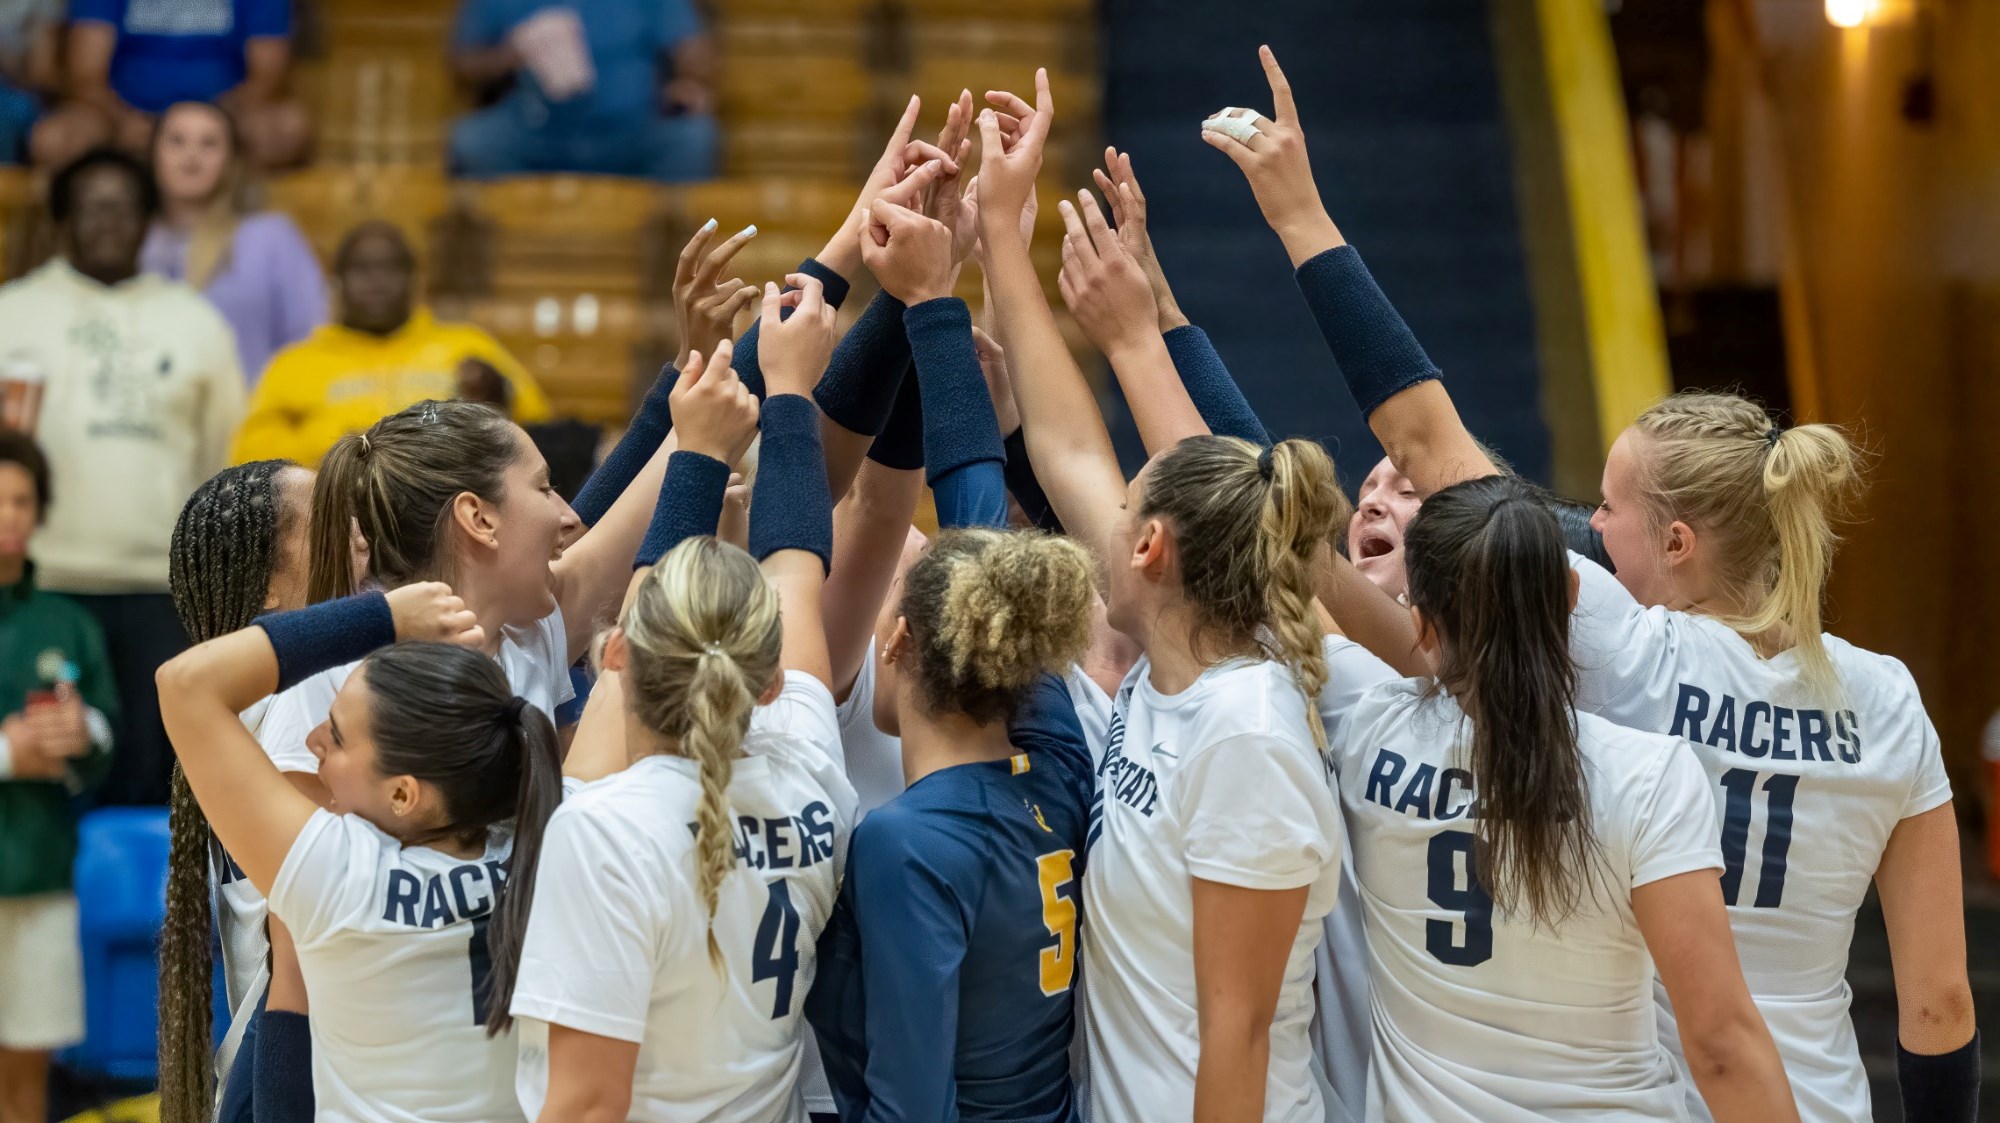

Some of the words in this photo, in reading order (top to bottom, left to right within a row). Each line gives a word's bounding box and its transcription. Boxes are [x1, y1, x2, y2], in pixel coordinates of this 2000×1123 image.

[1115, 757, 1158, 817] STATE
[1365, 748, 1487, 821] RAC
[1669, 683, 1862, 764] RACERS
[1426, 830, 1493, 967] 9
[1719, 767, 1800, 908] 11
[752, 878, 800, 1020] 4
[1035, 849, 1075, 997] 5
